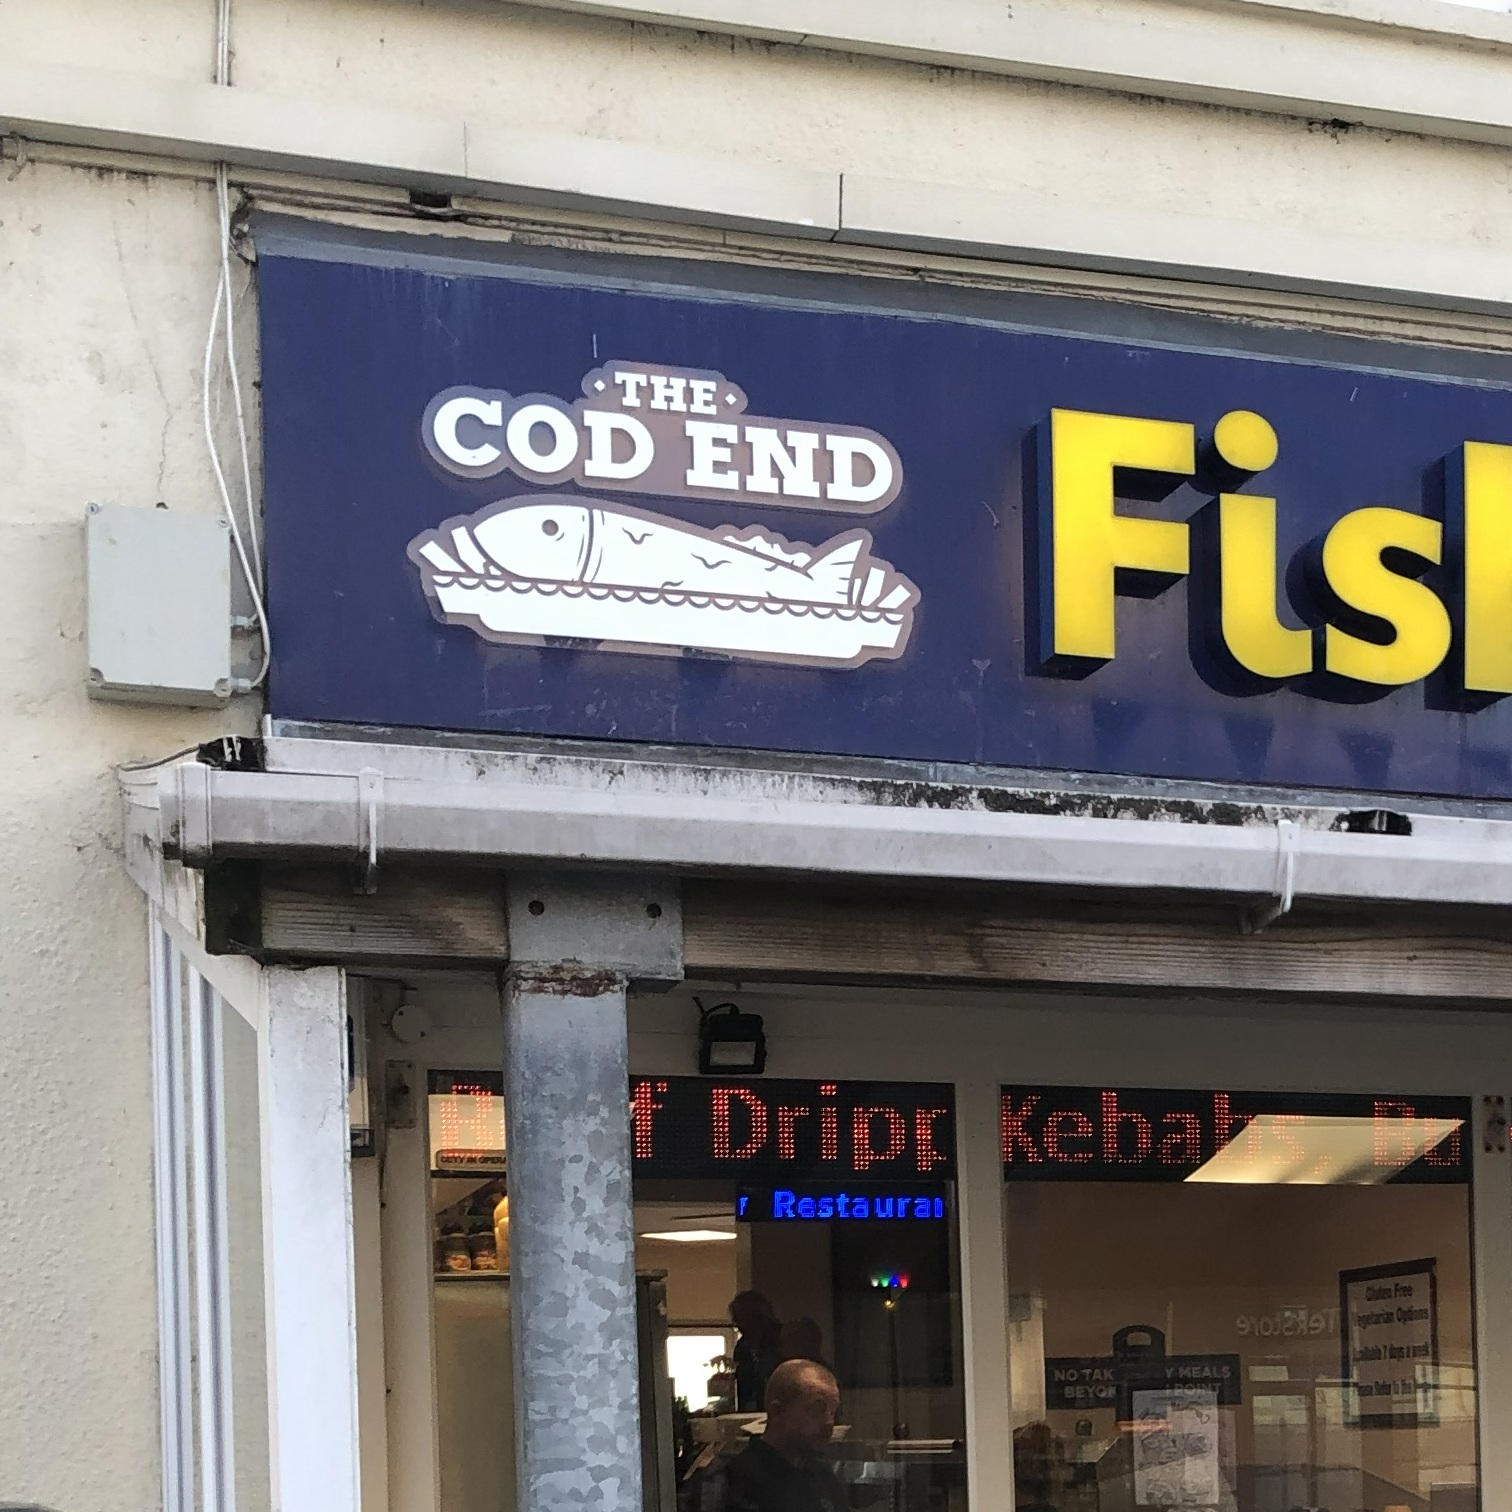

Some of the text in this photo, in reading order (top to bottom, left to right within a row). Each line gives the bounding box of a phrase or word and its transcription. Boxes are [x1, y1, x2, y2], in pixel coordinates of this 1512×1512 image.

[614, 371, 718, 414] THE
[432, 396, 895, 503] COD END
[1054, 1368, 1078, 1382] NO
[1178, 1364, 1232, 1379] MEALS
